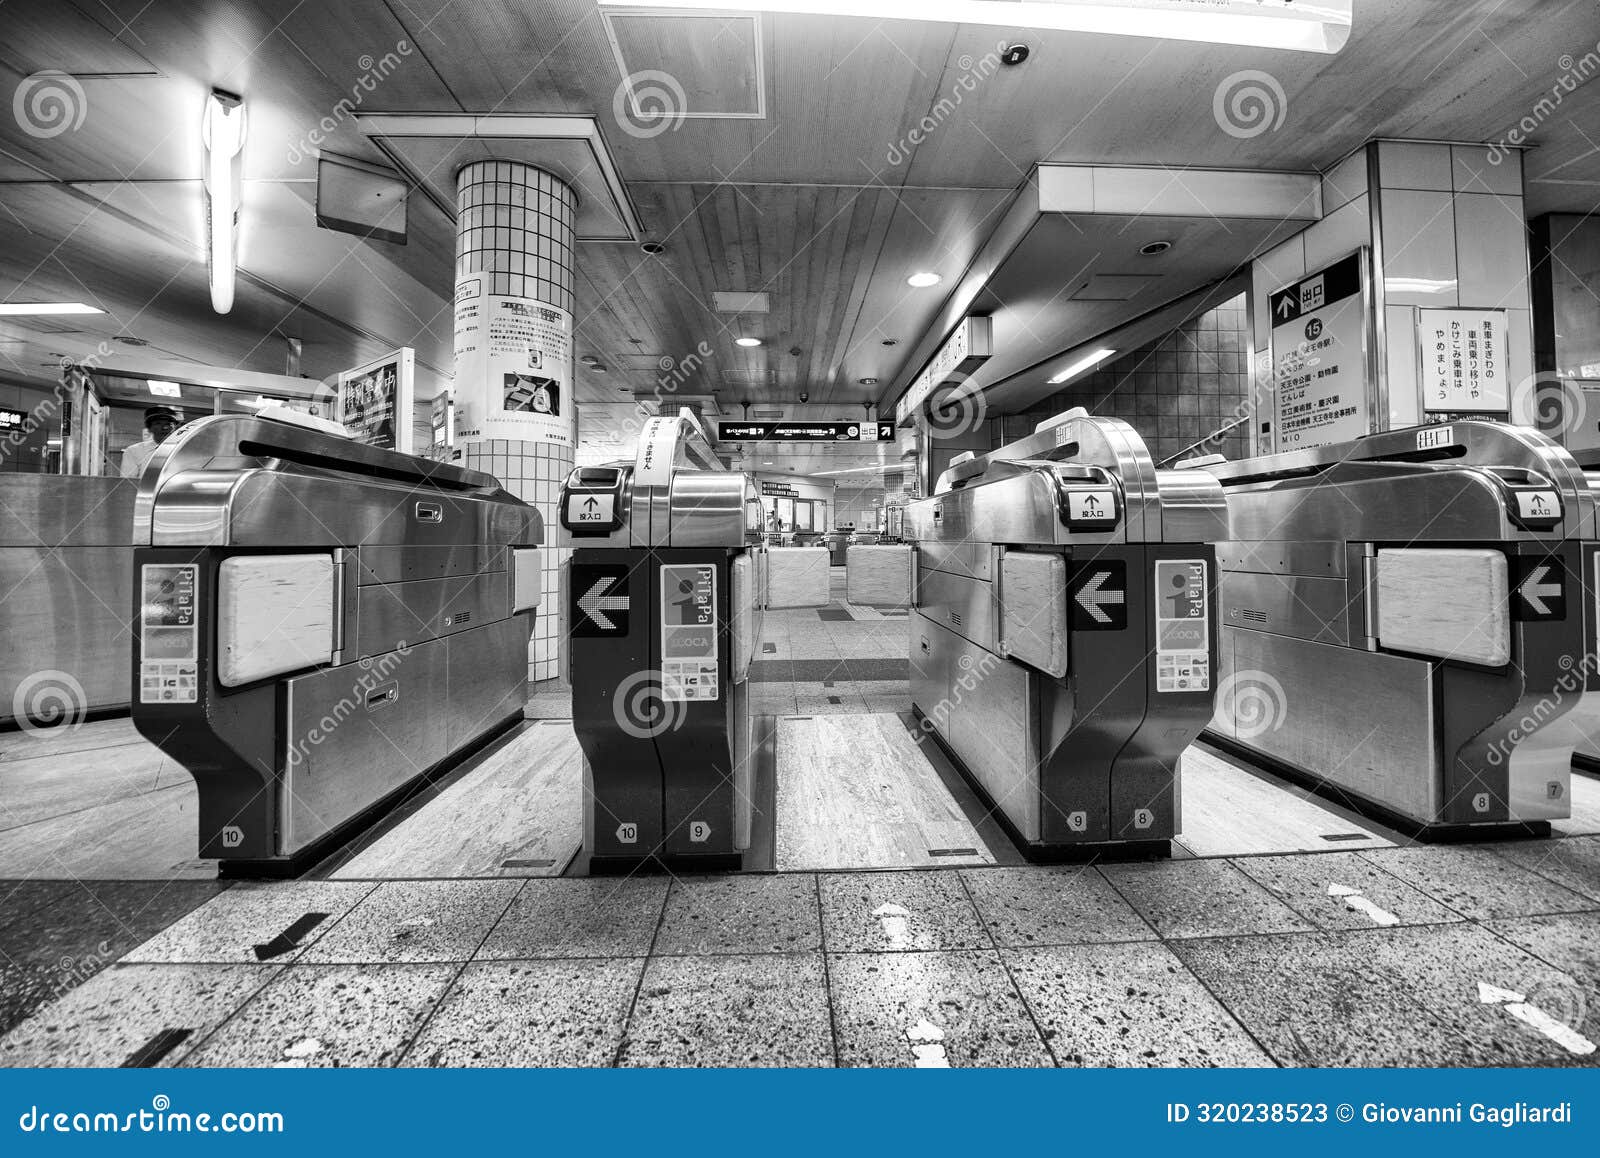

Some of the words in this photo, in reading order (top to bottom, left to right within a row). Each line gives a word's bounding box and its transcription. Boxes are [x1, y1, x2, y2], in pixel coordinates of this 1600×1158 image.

[1302, 284, 1322, 304] 出口
[1308, 322, 1320, 337] 15
[1451, 321, 1462, 388] かけこみ乗車は
[1483, 321, 1494, 378] 発車まぎわの
[1436, 330, 1447, 400] やめましょう
[1468, 330, 1479, 399] 車両乗り移りや
[579, 513, 601, 521] 投入口
[1082, 510, 1104, 518] 投入口
[1530, 508, 1551, 516] 投入口
[178, 568, 194, 624] PiTaPa
[697, 569, 713, 623] PiTaPa
[1188, 566, 1203, 617] PiTaPa
[225, 831, 238, 842] 10
[621, 827, 635, 839] 10
[694, 825, 703, 837] 9
